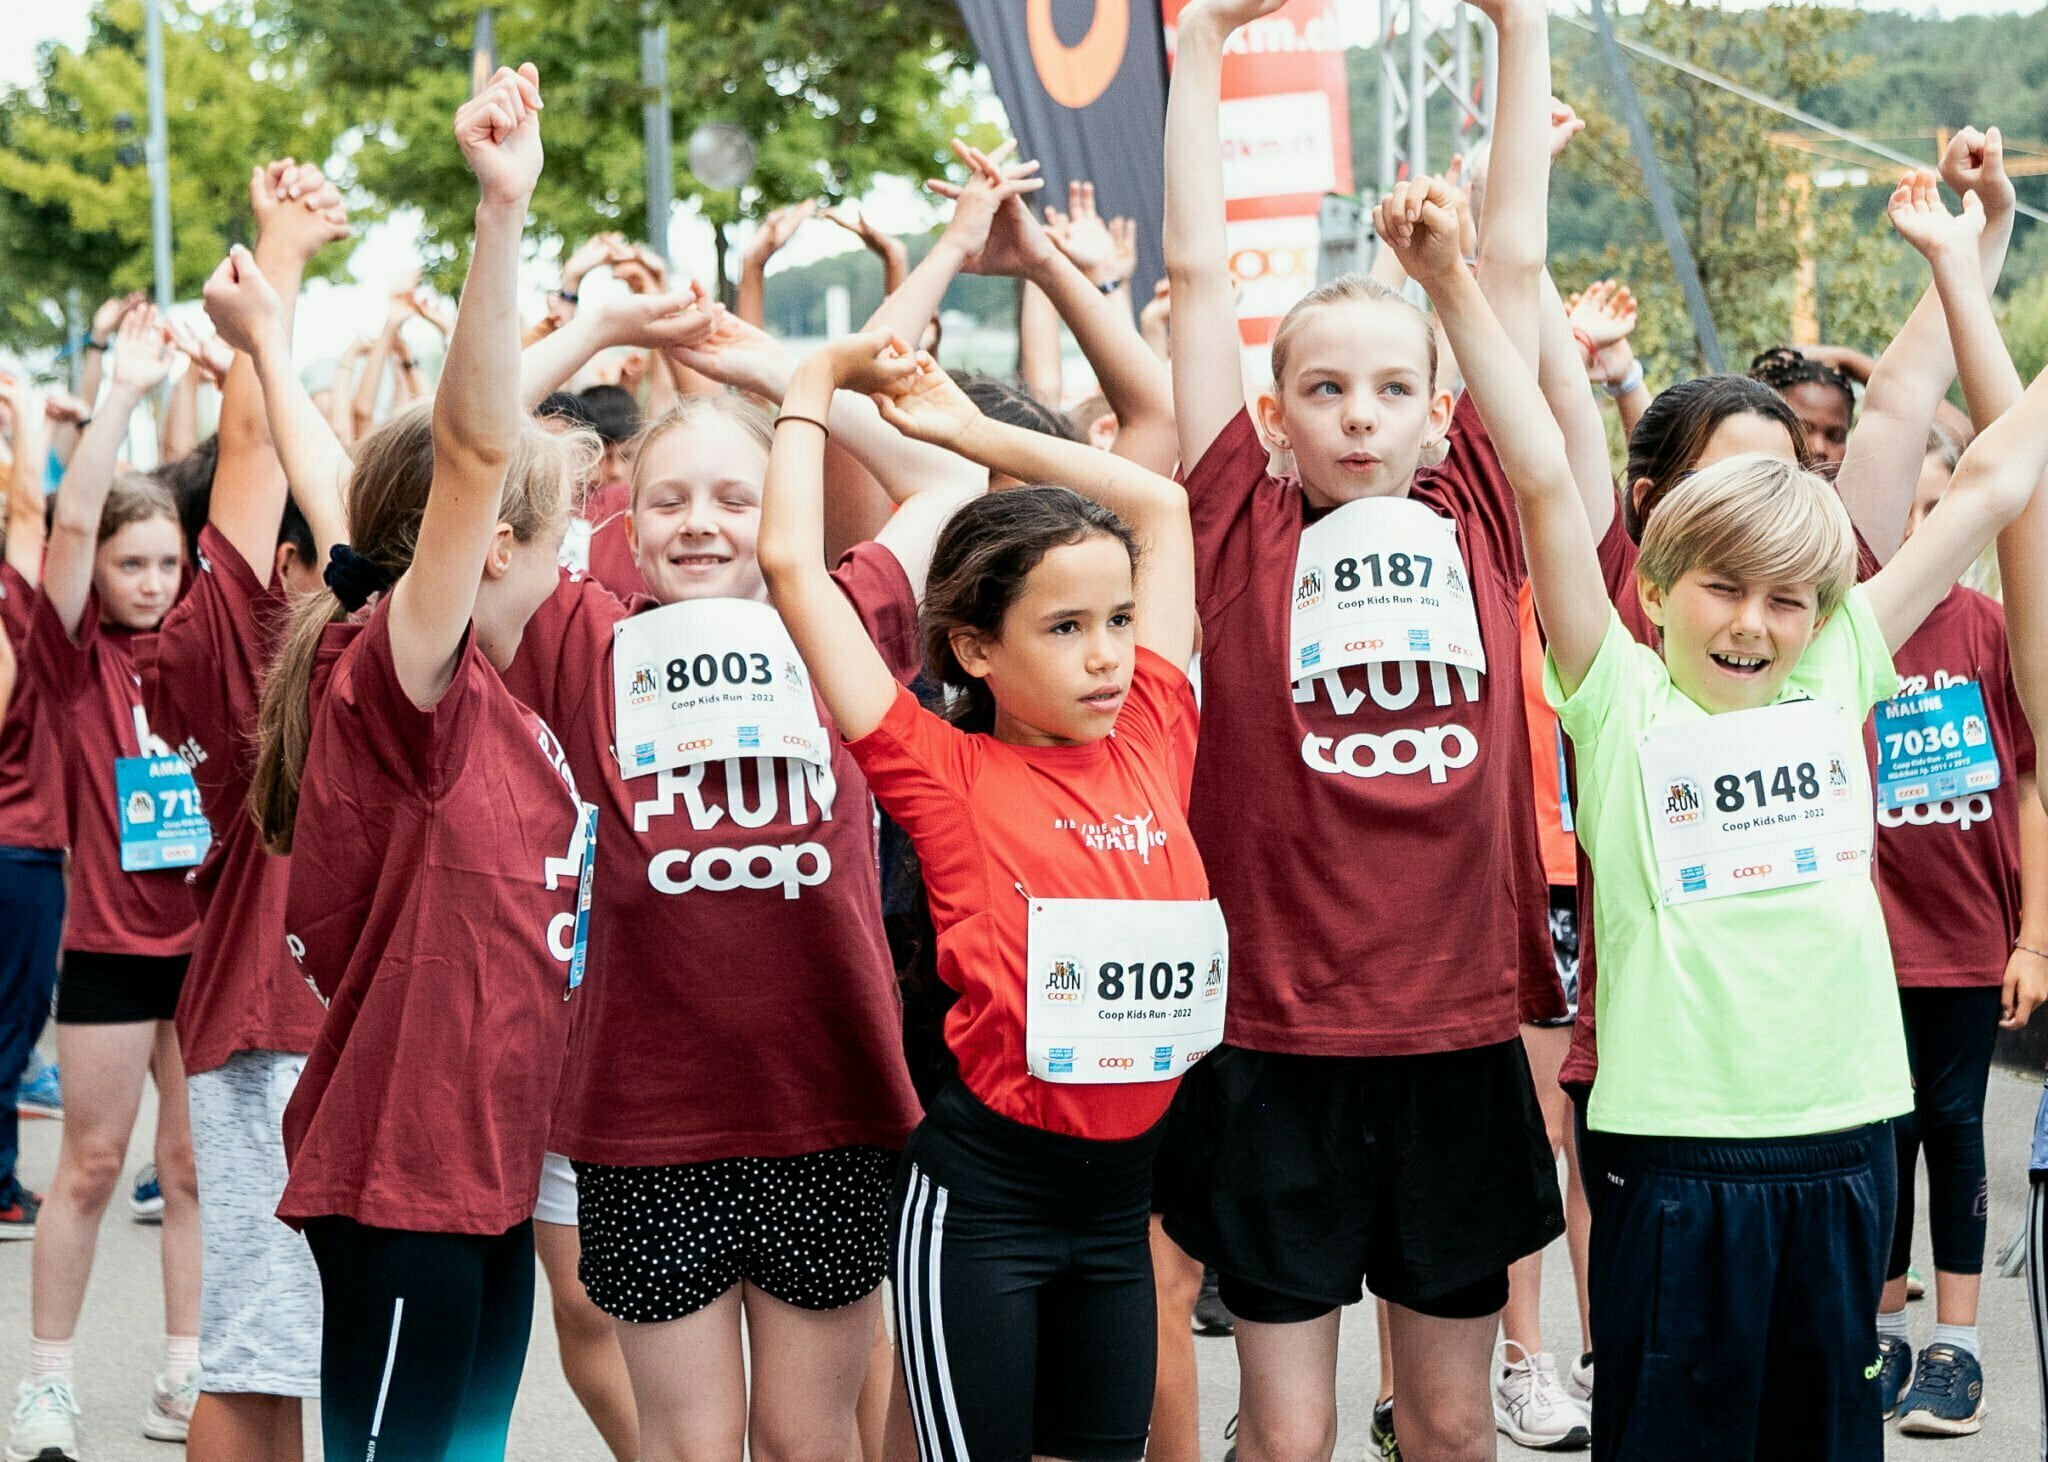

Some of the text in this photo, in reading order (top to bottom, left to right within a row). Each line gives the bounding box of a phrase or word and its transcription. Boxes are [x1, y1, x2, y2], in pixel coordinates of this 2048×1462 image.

[1334, 552, 1433, 593] 8187
[1296, 578, 1321, 602] RUN
[1337, 600, 1365, 610] Coop
[1367, 595, 1390, 605] Kids
[1392, 595, 1413, 604] Run
[1420, 596, 1440, 608] 2022
[1344, 639, 1384, 652] coop
[666, 652, 773, 693] 8003
[629, 676, 657, 696] RUN
[671, 699, 696, 711] Coop
[698, 694, 720, 705] Kids
[722, 693, 743, 702] Run
[751, 693, 775, 702] 2022
[1886, 695, 1943, 719] MALINE
[677, 735, 812, 752] coop coop
[1885, 720, 1960, 760] 7036
[1301, 723, 1479, 784] coop
[1714, 762, 1820, 813] 8148
[1665, 792, 1699, 814] RUN
[1669, 812, 1698, 824] coop
[1722, 820, 1751, 832] Coop
[1753, 816, 1776, 827] Kids
[1777, 813, 1797, 823] Run
[1804, 808, 1825, 819] 2022
[647, 841, 832, 900] coop
[1733, 864, 1773, 878] coop
[1045, 972, 1080, 990] RUN
[1097, 961, 1195, 1001] 8103
[1048, 992, 1078, 1002] coop
[1098, 1010, 1125, 1020] Coop
[1126, 1009, 1147, 1019] Kids
[1148, 1009, 1167, 1019] Run
[1173, 1008, 1192, 1018] 2022
[1099, 1057, 1134, 1070] coop
